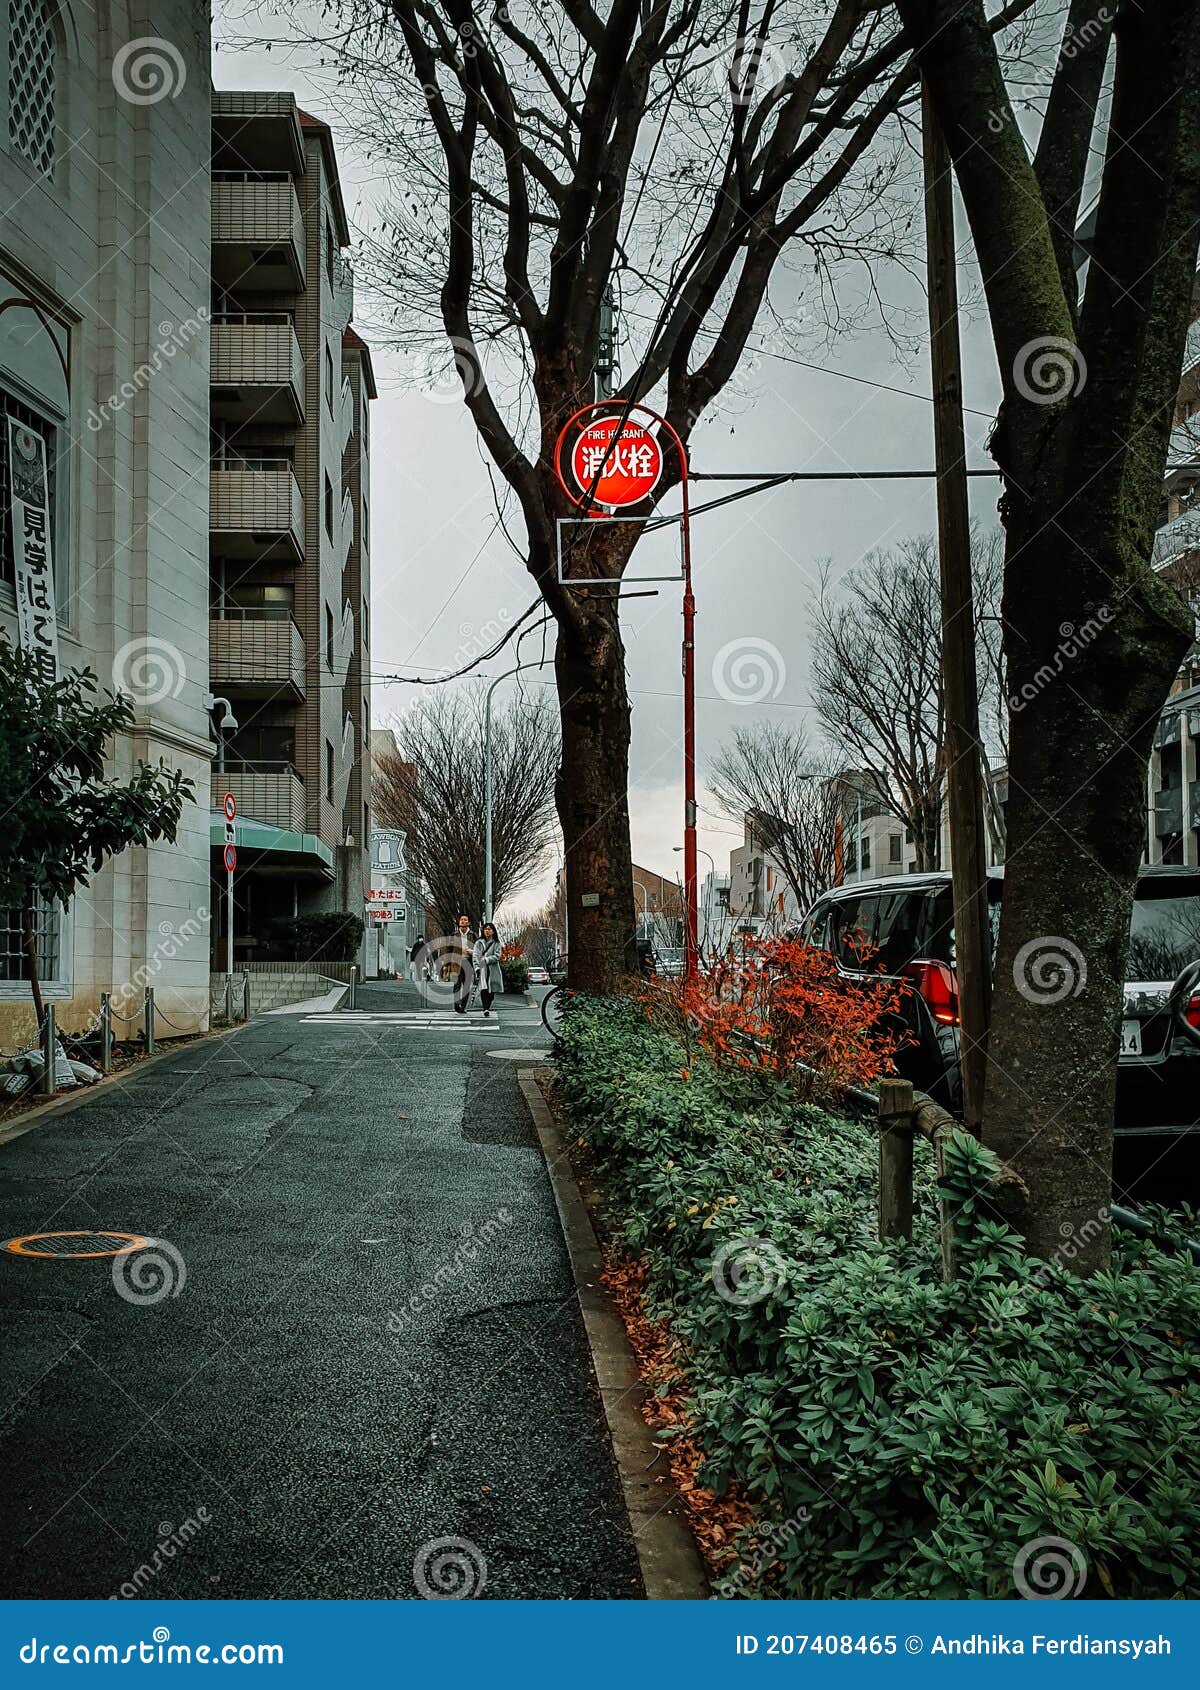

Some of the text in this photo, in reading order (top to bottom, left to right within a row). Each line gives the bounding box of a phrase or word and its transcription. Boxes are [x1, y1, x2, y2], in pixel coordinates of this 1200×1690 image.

[587, 429, 645, 439] FIRE HRANT
[581, 444, 654, 479] 消火栓
